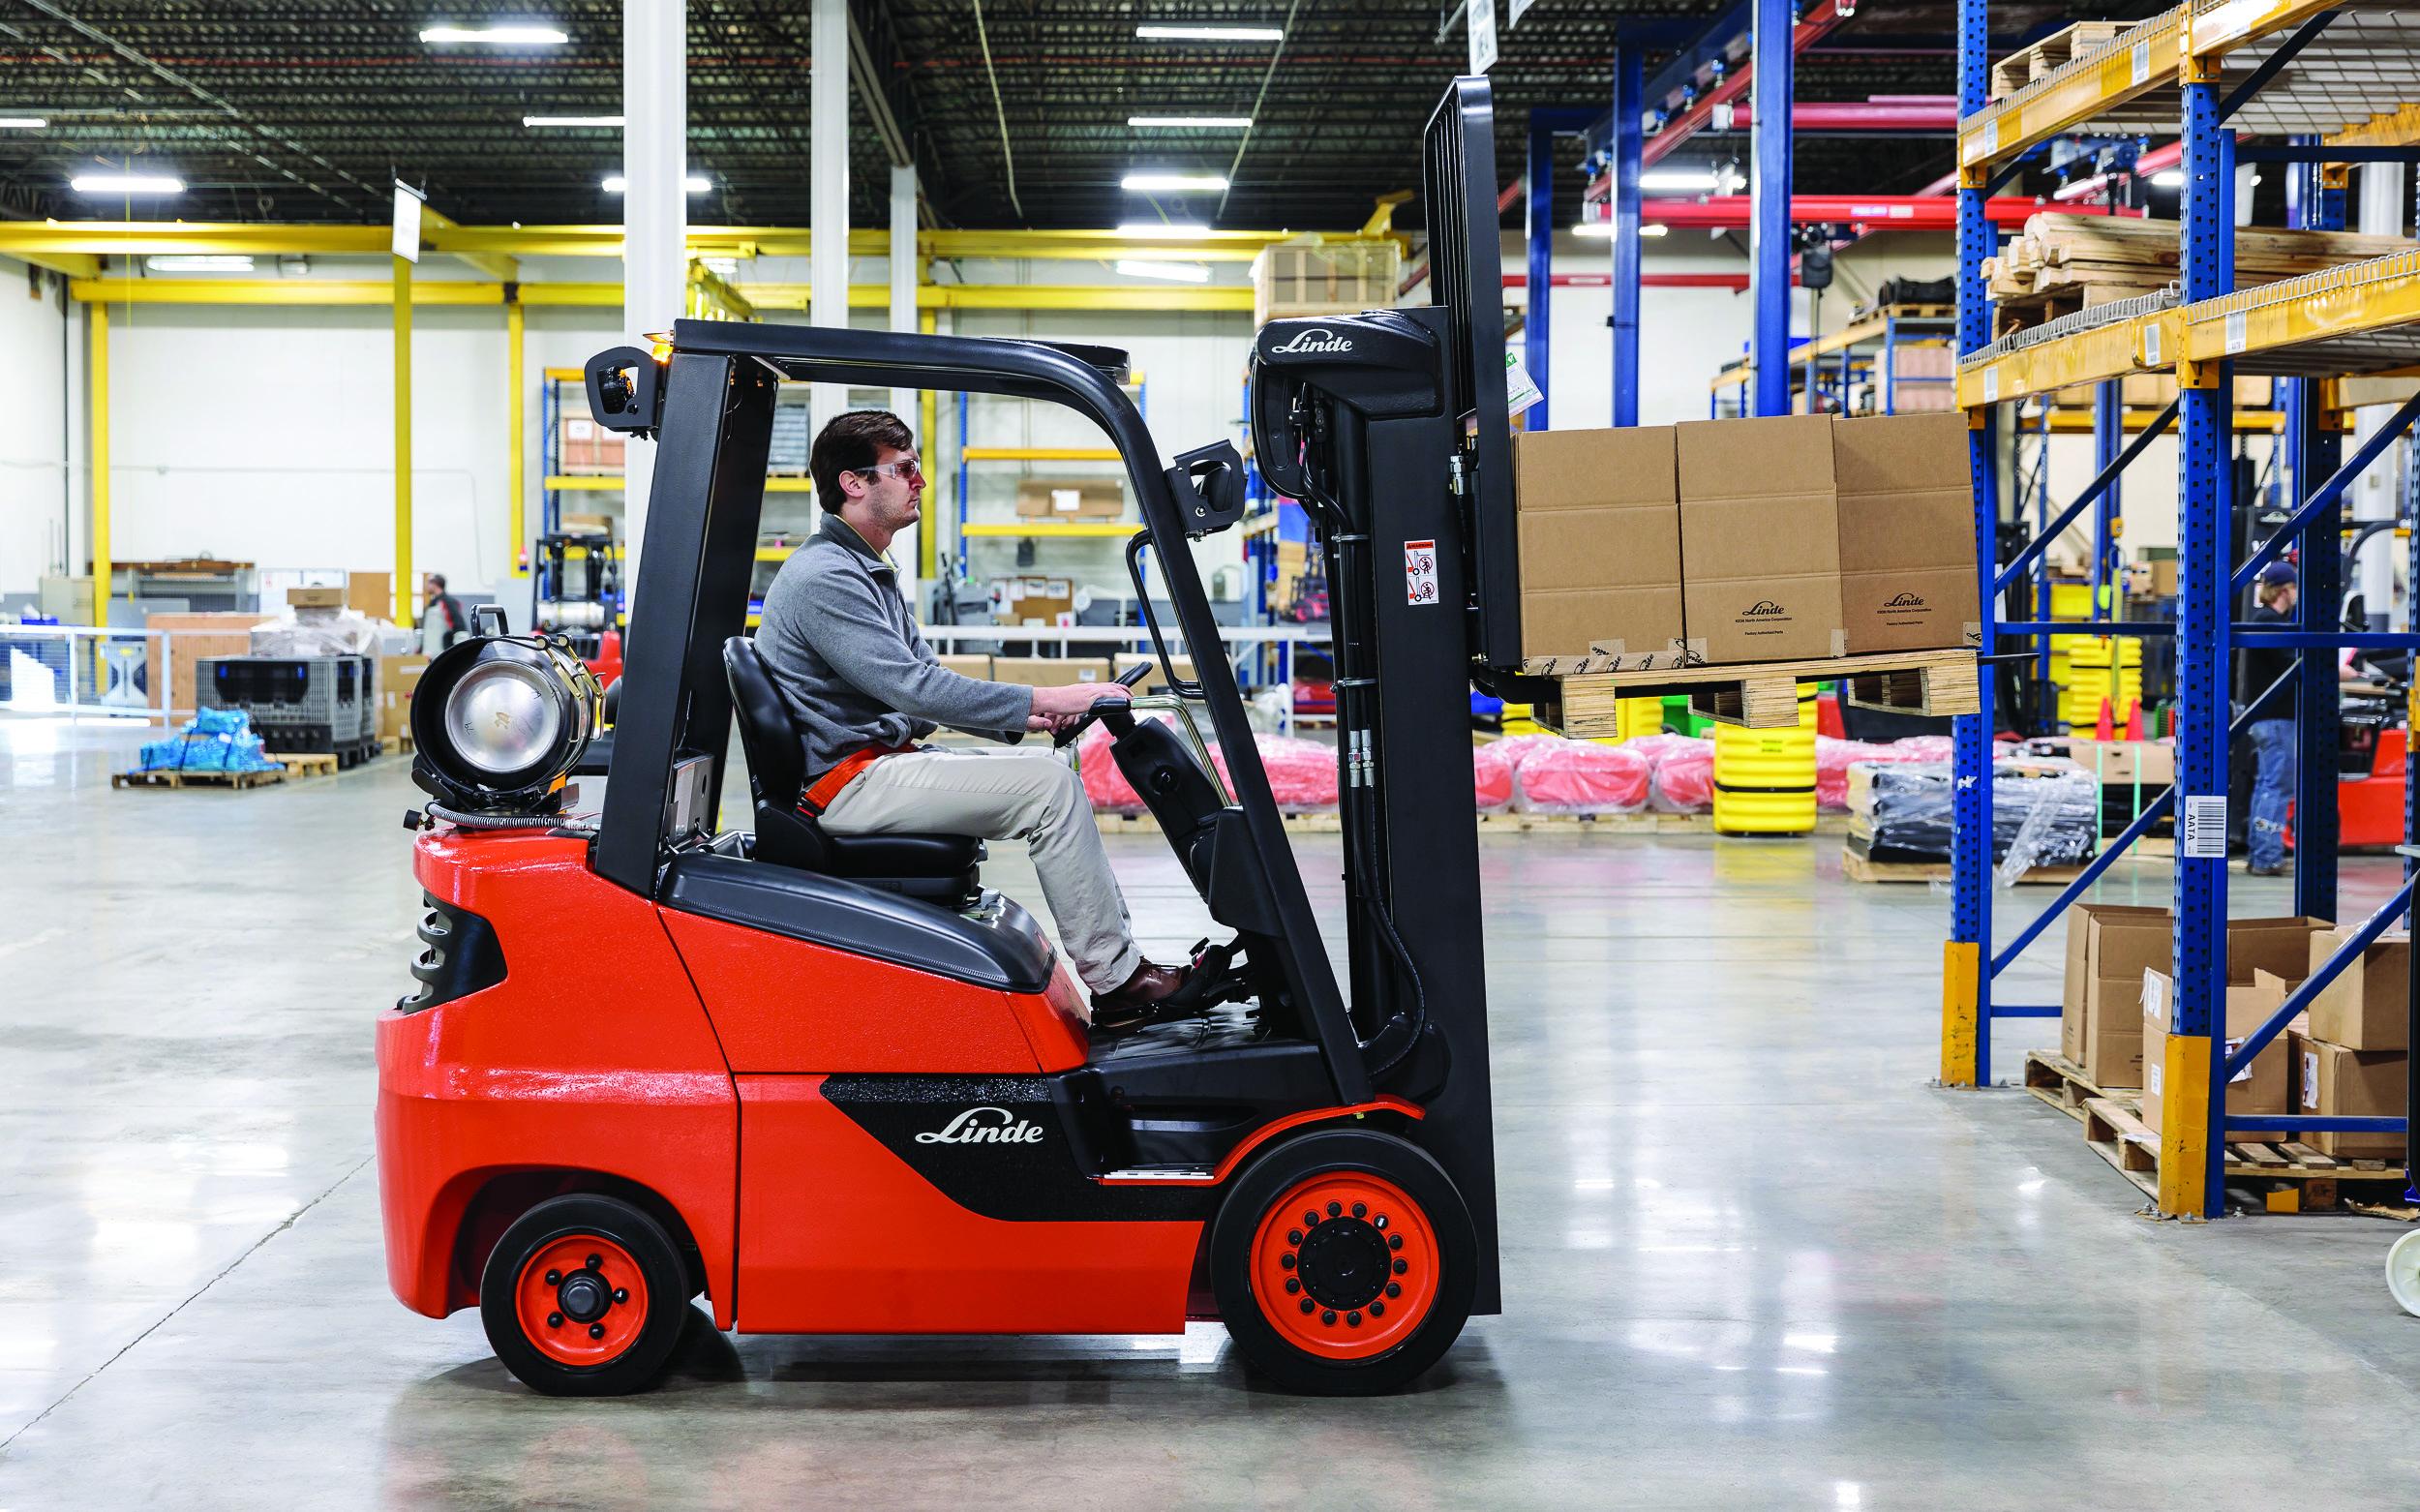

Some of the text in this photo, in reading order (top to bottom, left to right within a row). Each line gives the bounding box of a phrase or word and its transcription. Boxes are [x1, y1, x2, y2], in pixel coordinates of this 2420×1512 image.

[1271, 328, 1353, 353] Linde
[1742, 600, 1785, 616] Linde
[1884, 592, 1924, 607] Linde
[915, 1106, 1044, 1144] Linde
